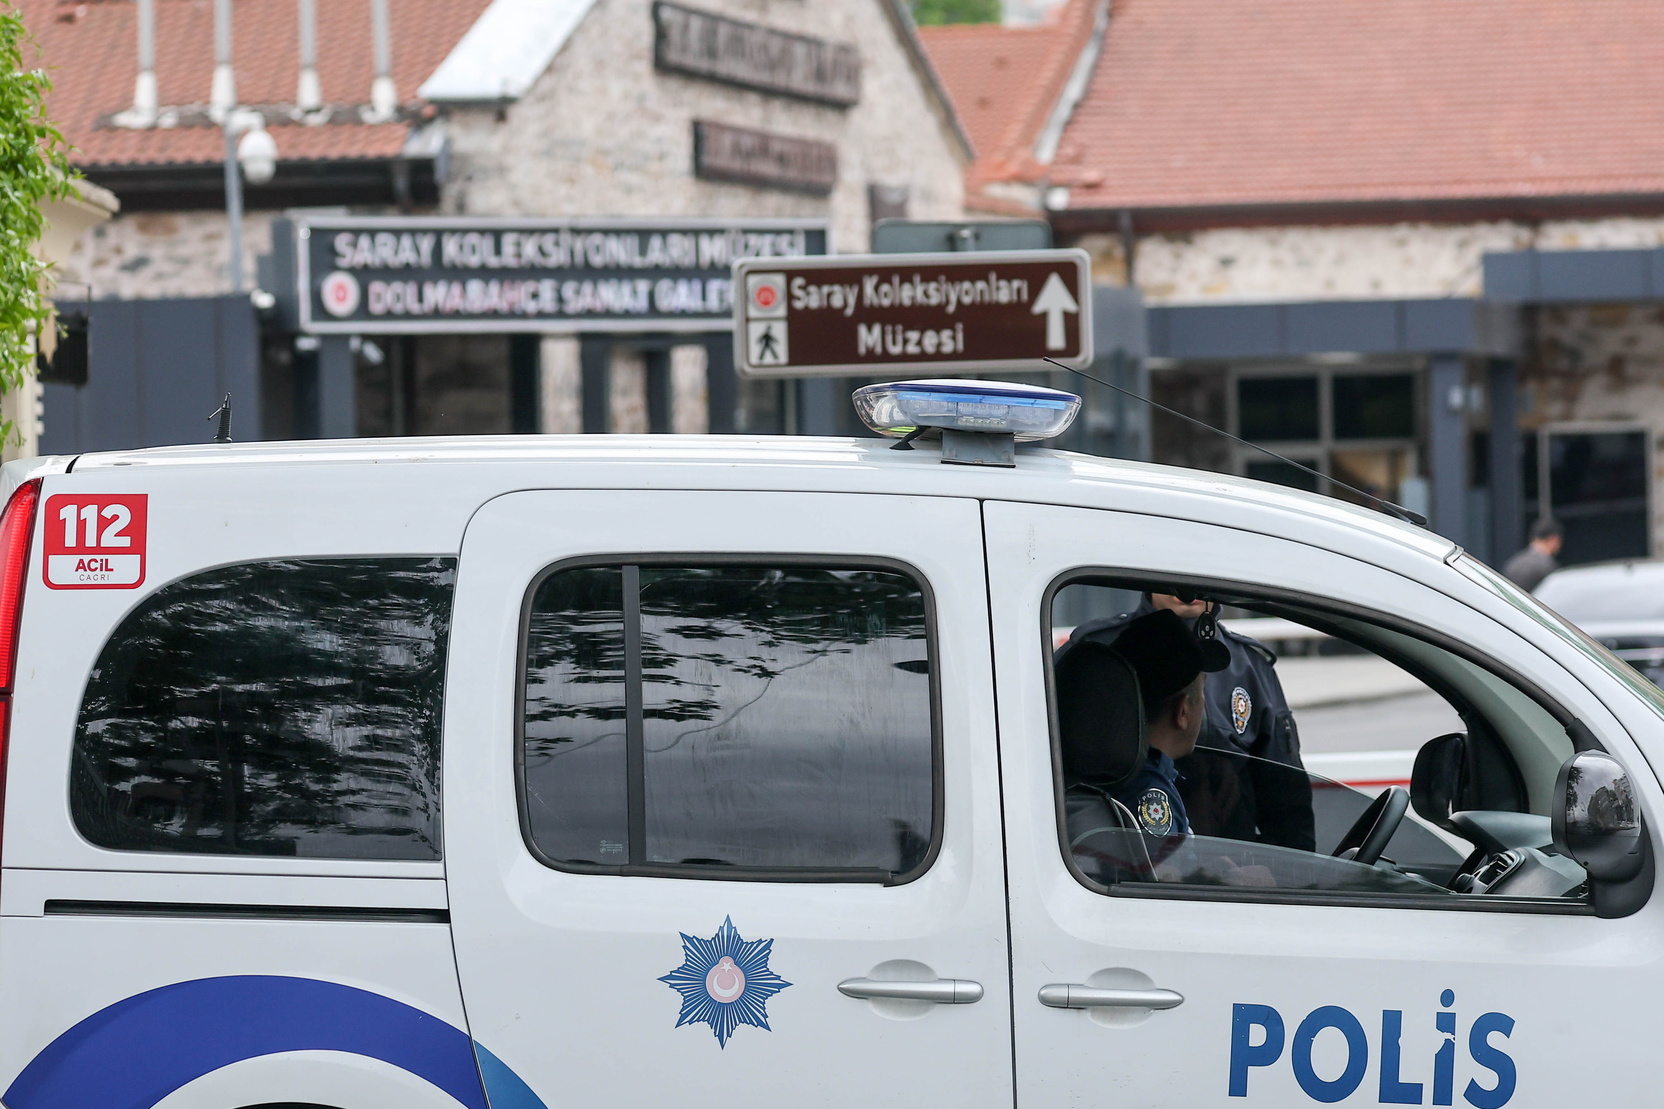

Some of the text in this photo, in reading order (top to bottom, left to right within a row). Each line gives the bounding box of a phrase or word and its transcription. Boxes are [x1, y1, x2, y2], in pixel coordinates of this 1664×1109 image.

[334, 232, 436, 268] SARAY
[368, 278, 558, 318] DOLMABAHÇE
[561, 278, 652, 315] SANAT
[790, 271, 1029, 316] Saray Koleksiyonları
[857, 322, 964, 356] Müzesi
[59, 503, 132, 548] 112
